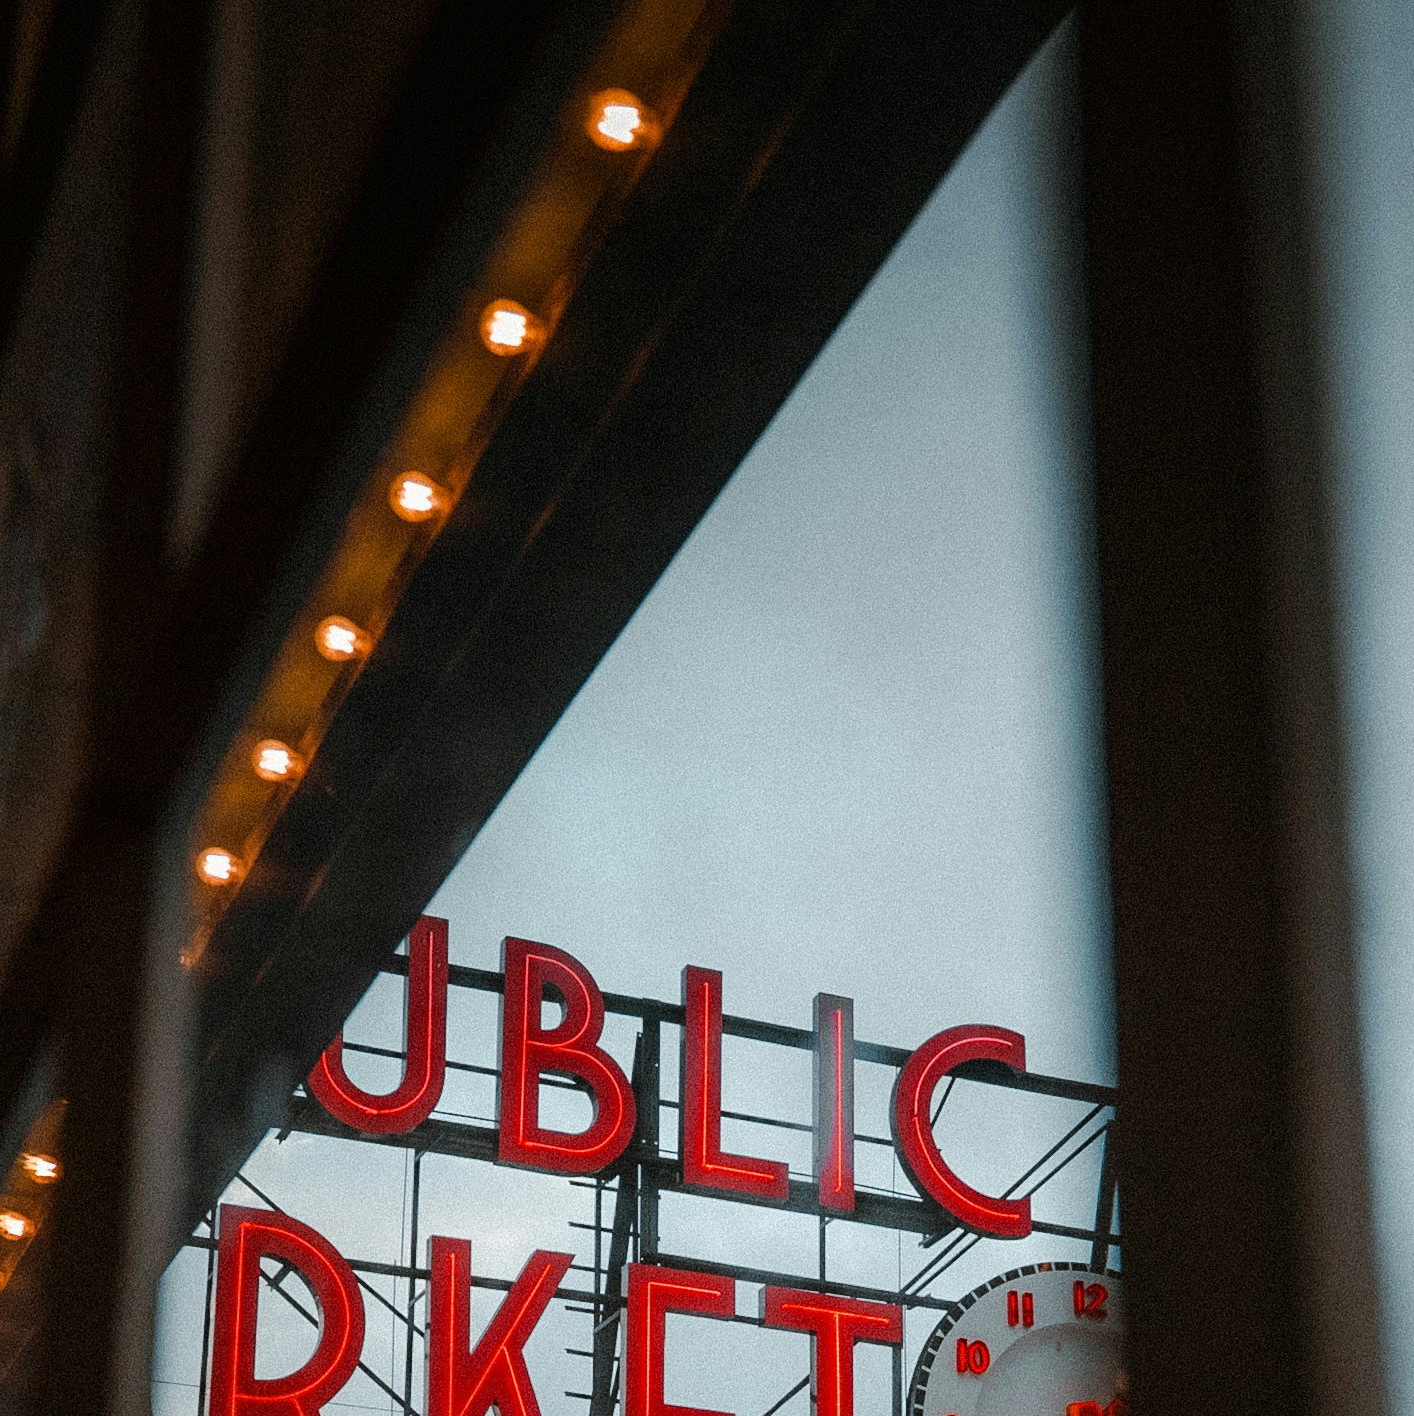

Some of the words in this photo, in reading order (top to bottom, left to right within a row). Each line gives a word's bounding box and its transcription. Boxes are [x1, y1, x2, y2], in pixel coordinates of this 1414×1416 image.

[305, 917, 1031, 1239] UBLIC
[1007, 1290, 1034, 1328] 11
[1073, 1279, 1109, 1320] 12
[956, 1337, 990, 1374] 10
